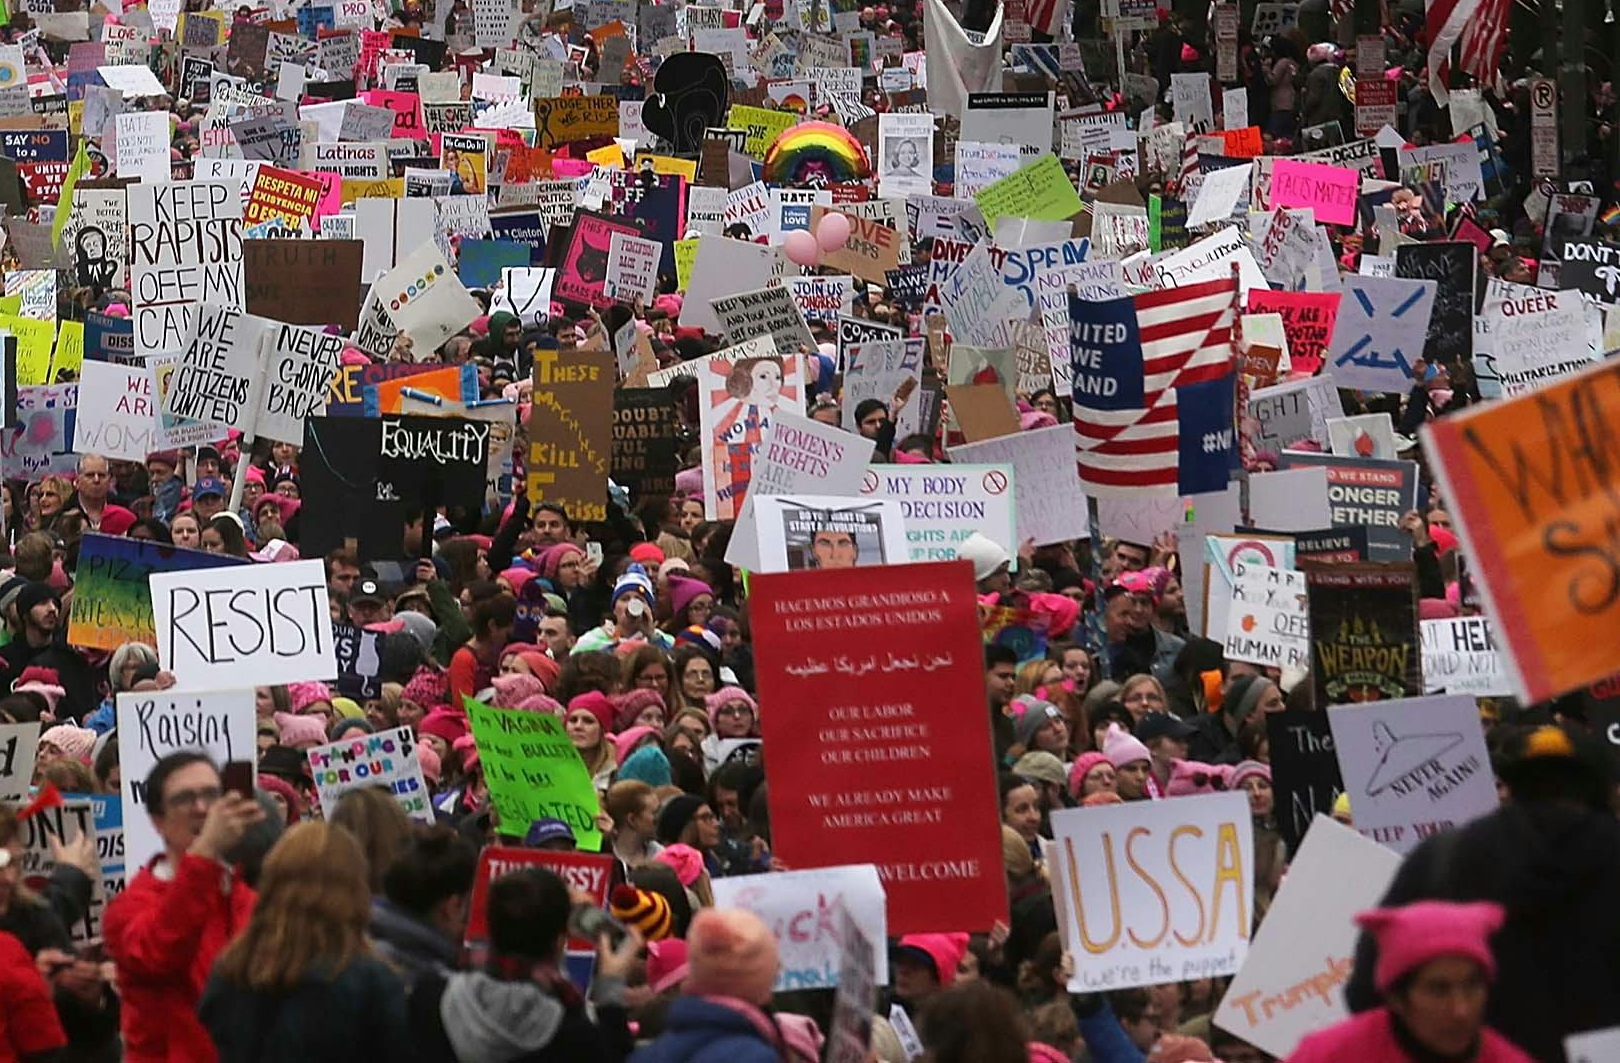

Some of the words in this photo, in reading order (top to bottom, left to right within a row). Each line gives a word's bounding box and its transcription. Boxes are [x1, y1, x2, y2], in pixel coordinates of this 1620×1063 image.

[342, 2, 366, 16] PRO
[429, 109, 469, 125] #LOVE
[5, 134, 28, 146] SAY
[31, 135, 50, 145] NO
[458, 140, 471, 149] Can
[16, 147, 28, 156] to
[316, 145, 376, 160] Latinas
[46, 175, 61, 183] WE
[346, 166, 378, 176] RIGHTS
[257, 174, 303, 198] RESPETA
[1277, 176, 1312, 199] FACTS
[1314, 181, 1353, 207] MATTER
[153, 185, 228, 222] KEEP
[254, 191, 312, 216] EXISTENCIA
[724, 195, 766, 222] WALL
[784, 216, 807, 225] LOVE
[131, 218, 244, 265] RAPISTS
[511, 228, 541, 238] Clinton
[1564, 242, 1613, 263] DON'T
[139, 268, 198, 304] OFF
[202, 263, 241, 304] MY
[889, 275, 928, 289] LAWS
[1038, 273, 1068, 288] NOT
[1072, 263, 1116, 281] SMART
[793, 282, 823, 295] JOIN
[827, 283, 843, 294] US
[712, 300, 738, 315] KEEP
[741, 294, 762, 309] YOUR
[763, 288, 790, 304] HANDS
[796, 297, 842, 310] CONGRESS
[1501, 296, 1558, 316] QUEER
[198, 307, 240, 345] WE
[726, 316, 744, 327] AND
[184, 341, 228, 370] ARE
[276, 325, 342, 366] NEVER
[279, 359, 334, 394] GOING
[533, 351, 600, 384] THESE
[1499, 358, 1592, 385] MILITARIZATION
[180, 366, 250, 403] CITIZENS
[171, 390, 238, 425] UNITED
[269, 385, 323, 417] BACK
[382, 421, 489, 464] EQUALITY
[774, 424, 844, 461] WOMEN'S
[532, 442, 579, 468] KILL
[767, 444, 830, 478] RIGHTS
[759, 467, 796, 487] ARE
[888, 478, 911, 494] MY
[924, 477, 966, 495] BODY
[1359, 473, 1395, 483] STAND
[902, 501, 986, 518] DECISION
[1298, 538, 1350, 550] BELIEVE
[774, 595, 844, 614] HACEMOS
[848, 592, 936, 609] GRANDIOSO
[169, 585, 325, 670] RESIST
[786, 618, 812, 632] LOS
[815, 614, 881, 629] ESTADOS
[884, 610, 941, 625] UNIDOS
[1226, 636, 1281, 660] HUMAN
[1315, 641, 1408, 673] WEAPON
[829, 706, 860, 720] OUR
[863, 704, 914, 718] LABOR
[136, 701, 232, 763] Raising
[495, 714, 557, 735] VAGINA
[819, 728, 850, 742] OUR
[853, 725, 926, 739] SACRIFICE
[1291, 727, 1332, 751] The
[311, 738, 395, 764] STANDING
[821, 749, 852, 763] OUR
[855, 746, 930, 761] CHILDREN
[316, 770, 350, 786] FOR
[356, 761, 393, 778] OUR
[1390, 760, 1447, 799] NEVER
[808, 795, 832, 808] WE
[835, 789, 904, 806] ALREADY
[908, 787, 951, 801] MAKE
[822, 814, 890, 827] AMERICA
[893, 809, 942, 824] GREAT
[880, 860, 979, 881] WELCOME
[1149, 955, 1173, 976] the
